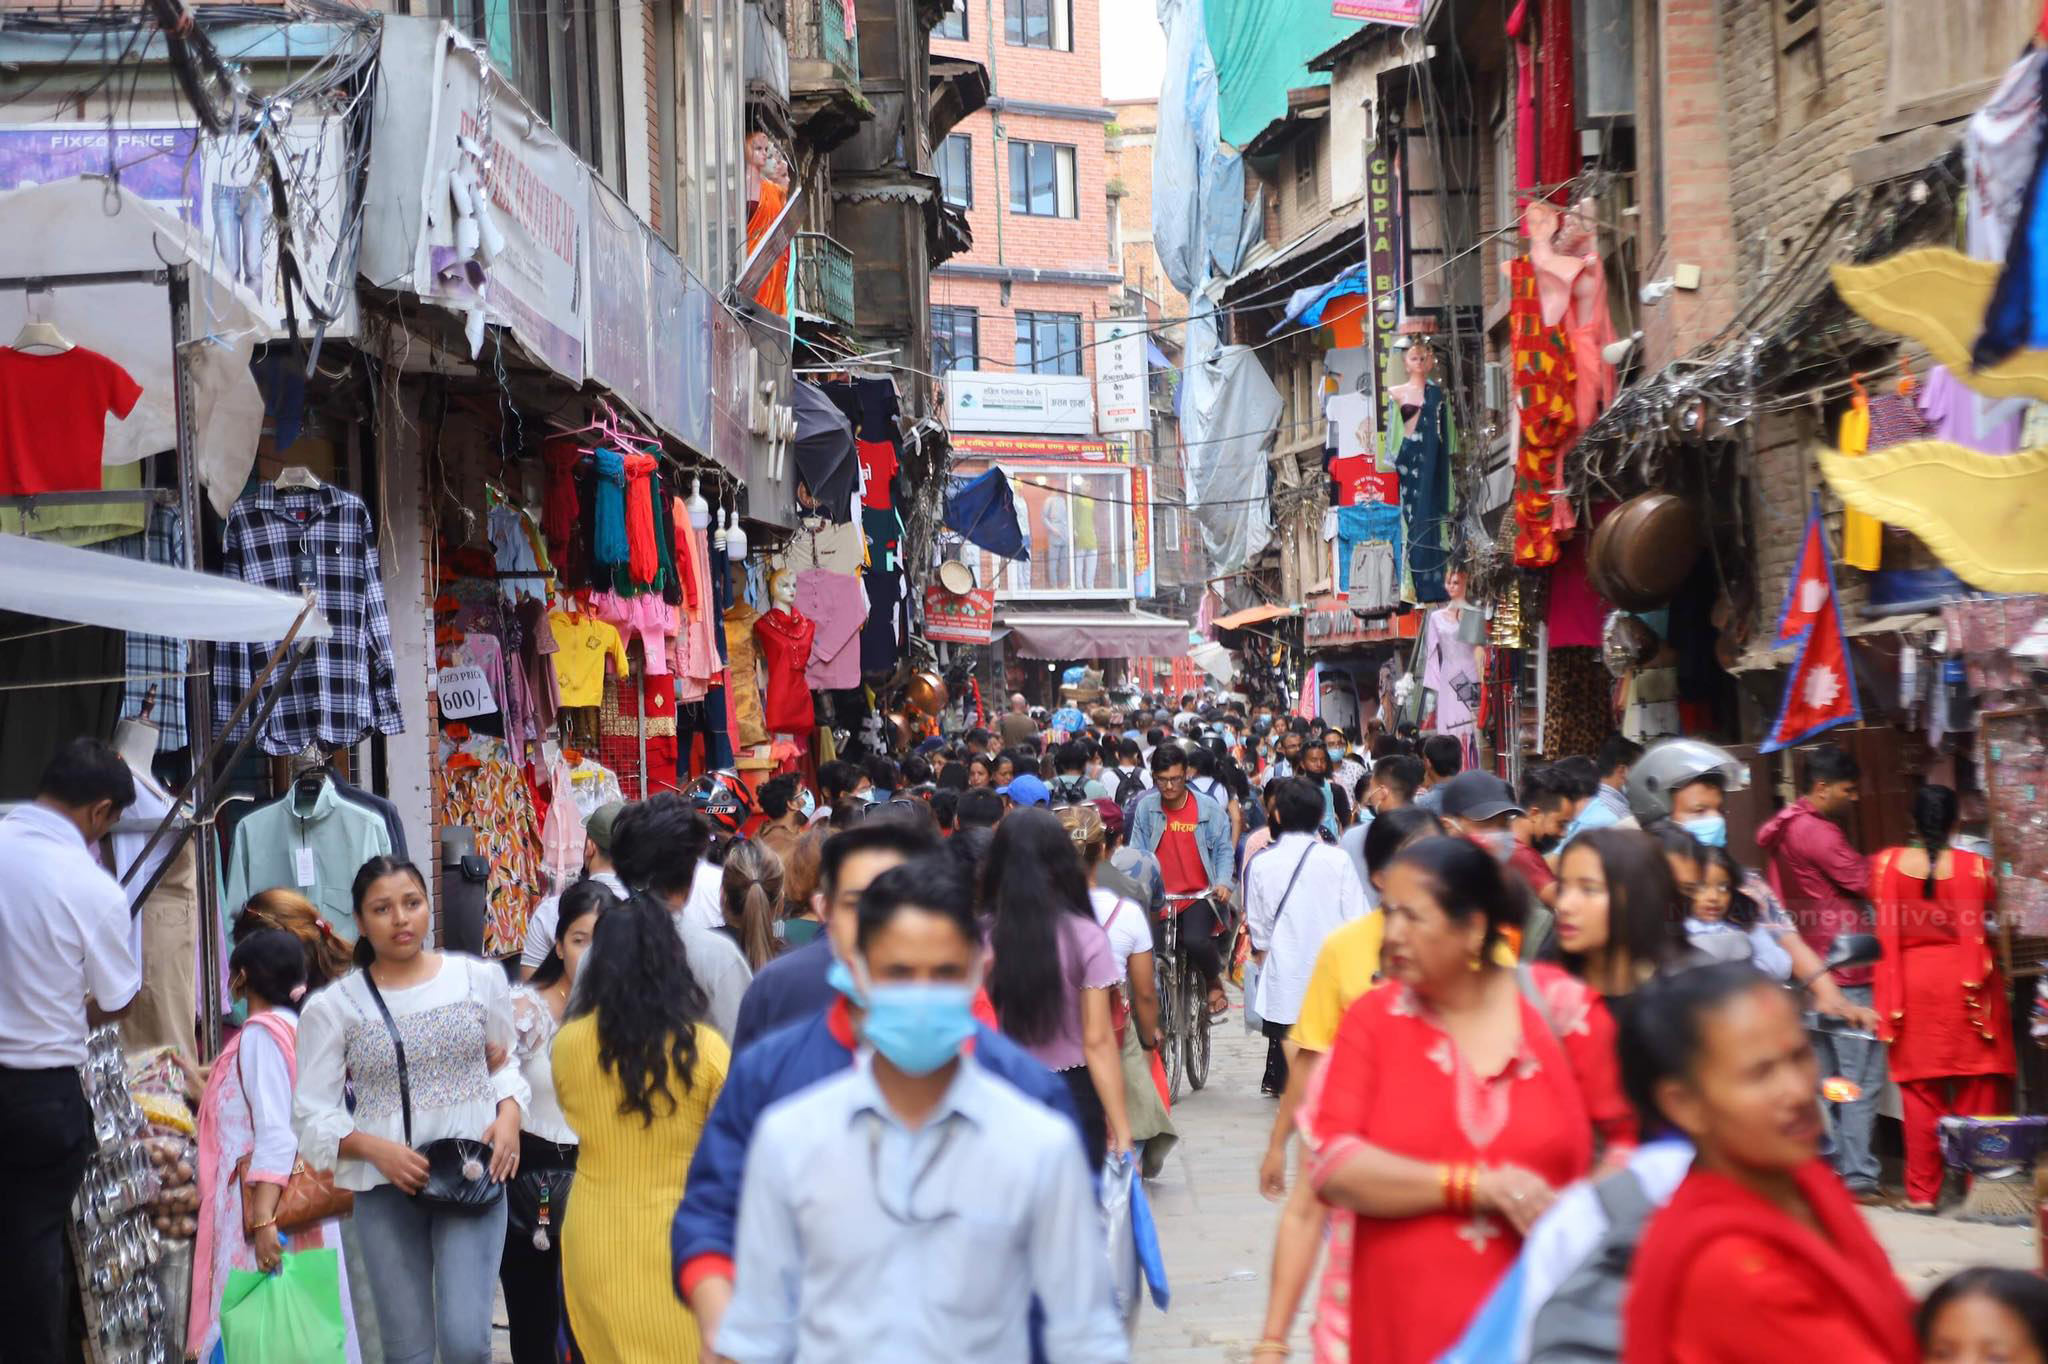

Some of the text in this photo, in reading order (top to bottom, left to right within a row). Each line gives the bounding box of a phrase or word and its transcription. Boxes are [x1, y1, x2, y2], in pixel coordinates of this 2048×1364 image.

[52, 135, 175, 148] FIXED PRICE
[1371, 159, 1389, 252] GUPTA
[442, 687, 489, 711] 600/-
